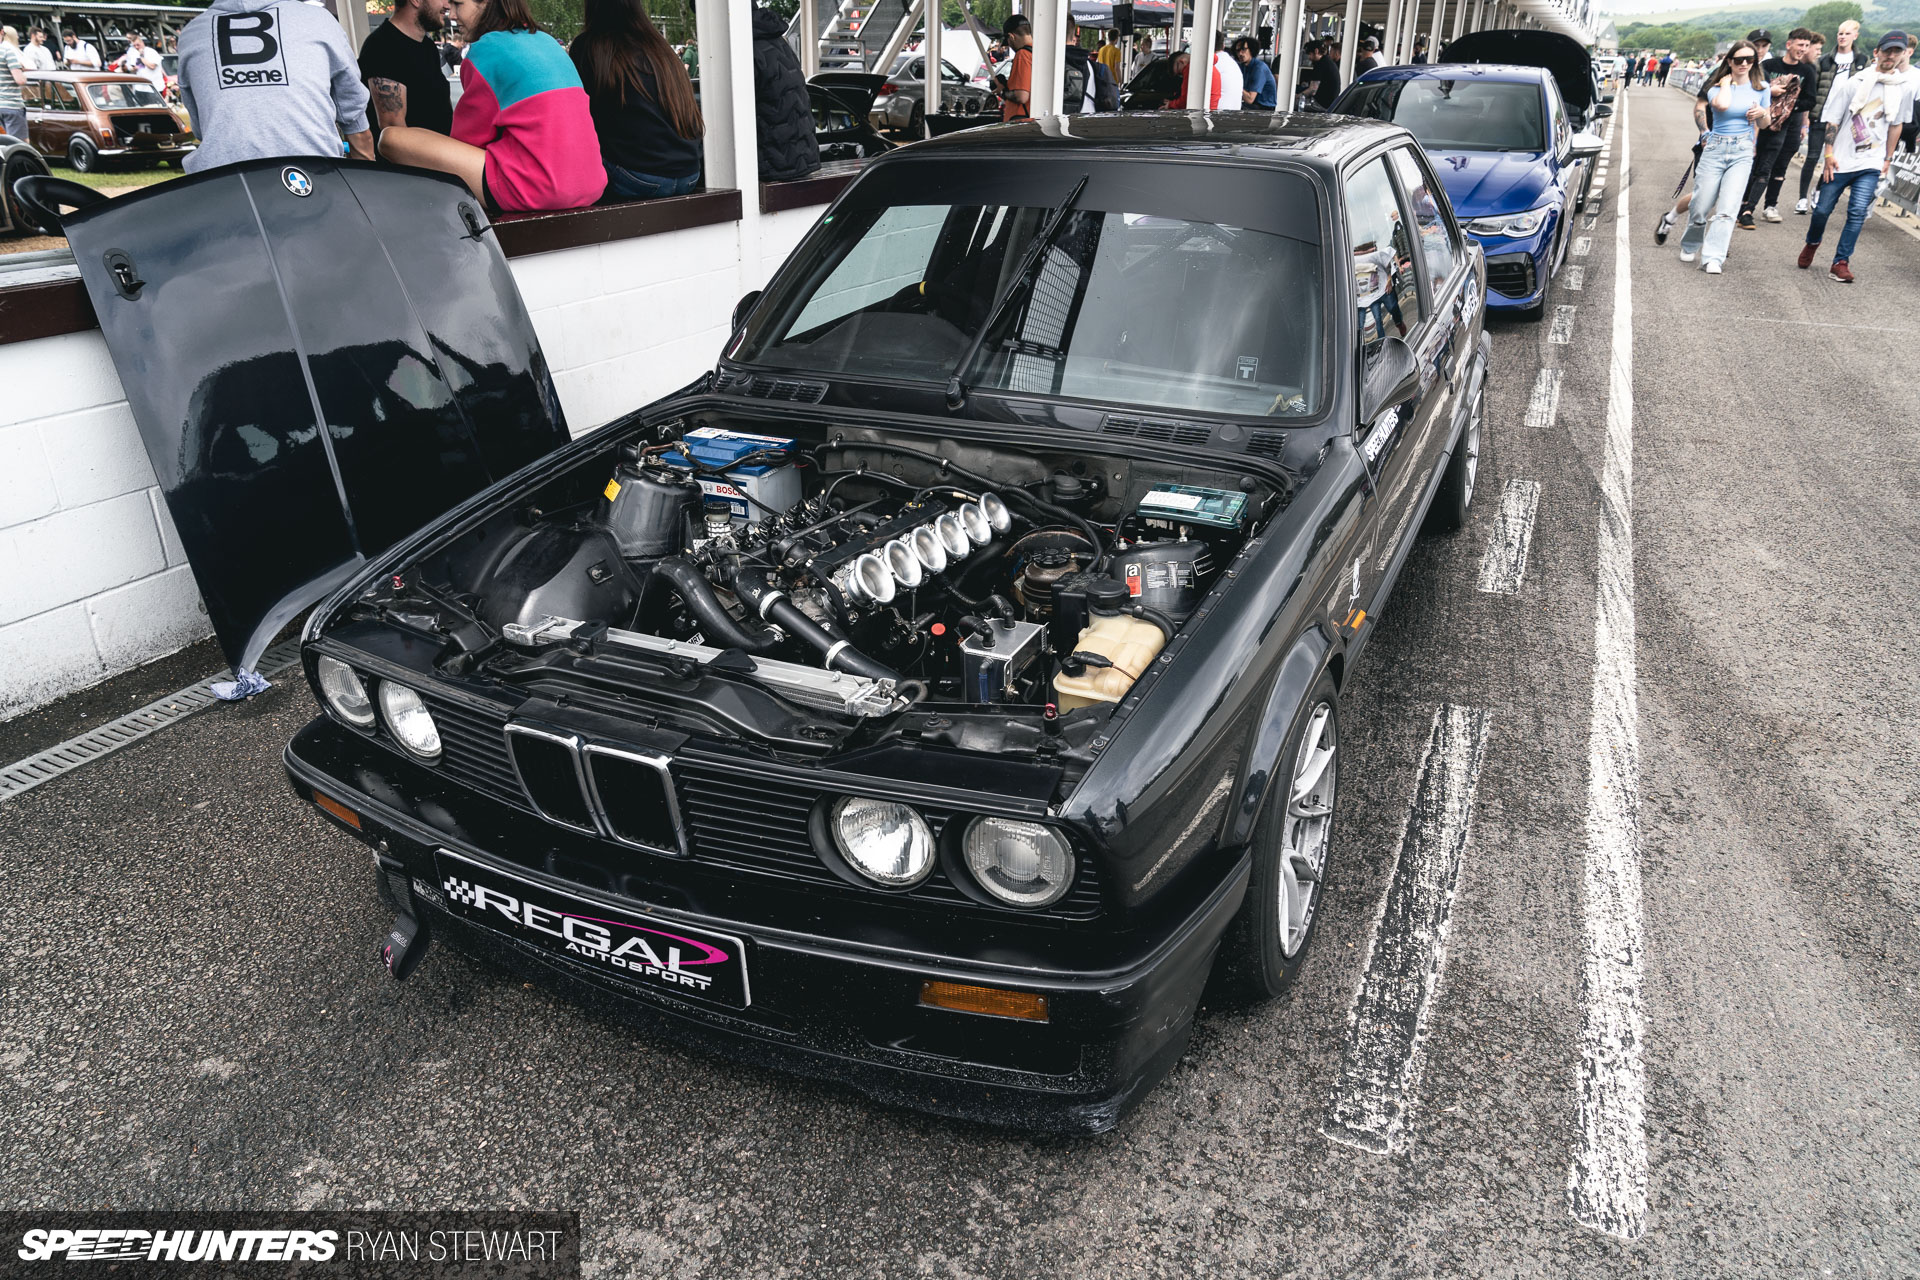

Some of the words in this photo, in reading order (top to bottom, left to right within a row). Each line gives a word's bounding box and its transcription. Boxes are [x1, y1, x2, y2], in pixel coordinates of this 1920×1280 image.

[217, 11, 278, 67] B
[222, 68, 282, 85] Scene
[1129, 565, 1138, 576] a
[473, 883, 712, 982] REGAL
[565, 942, 711, 990] AUTOSPORT
